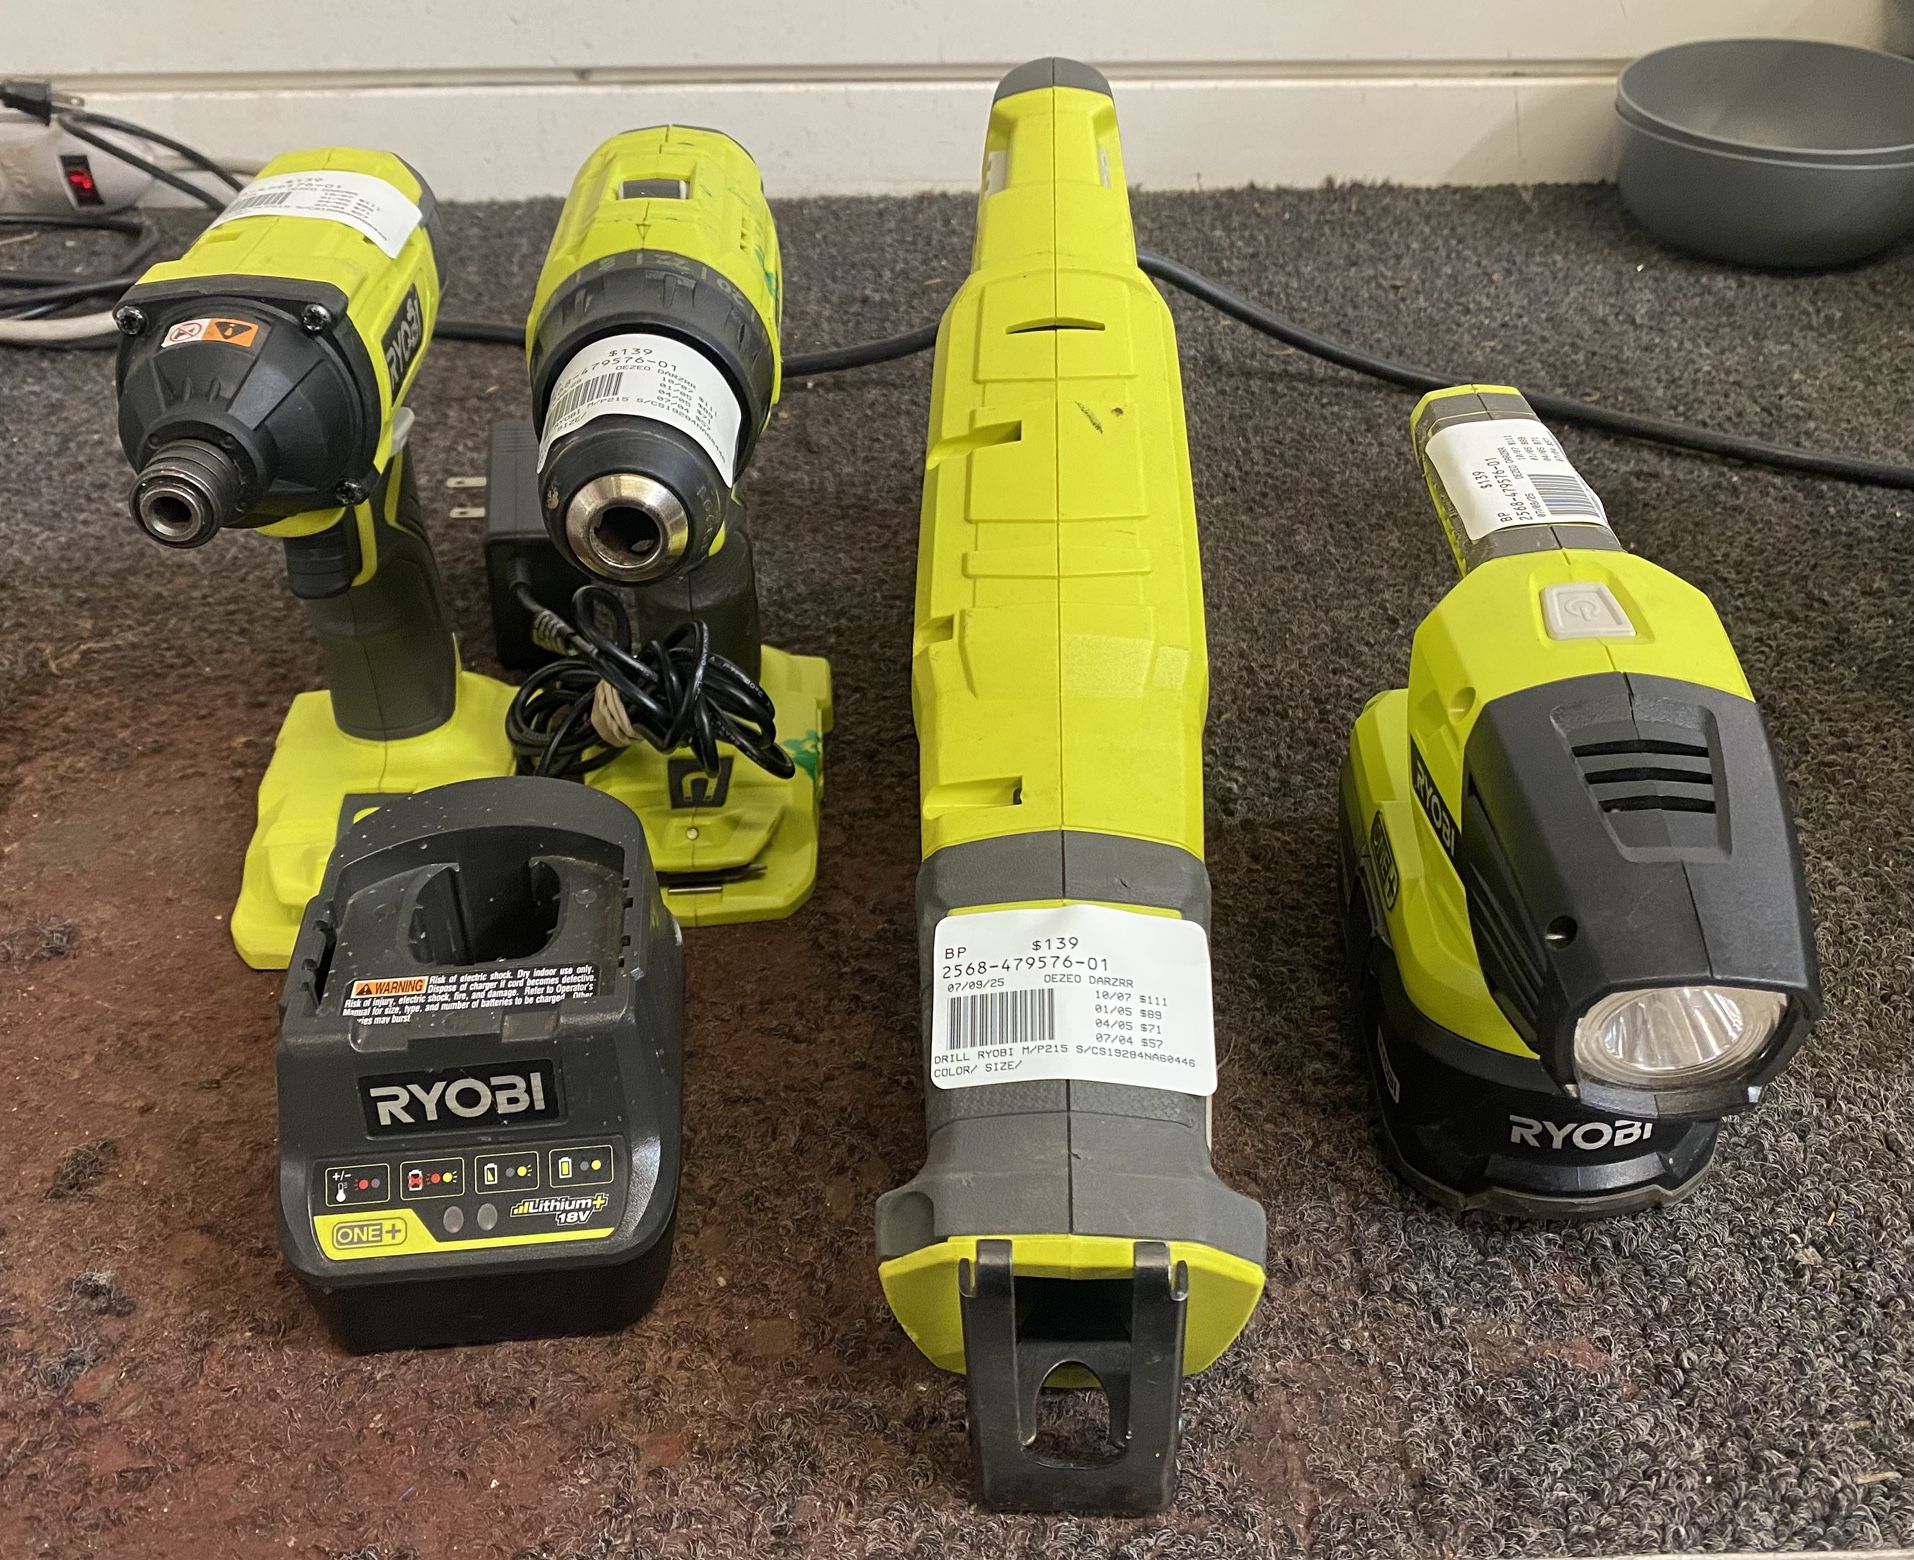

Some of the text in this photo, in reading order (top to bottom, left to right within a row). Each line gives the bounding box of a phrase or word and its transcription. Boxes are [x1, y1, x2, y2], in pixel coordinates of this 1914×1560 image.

[608, 348, 654, 358] $139
[1472, 471, 1493, 489] $139
[1484, 457, 1534, 521] 2568-479576-01
[1497, 512, 1513, 522] BP
[1416, 760, 1455, 857] RYOBI
[944, 946, 967, 960] BP
[1032, 936, 1079, 952] $139
[429, 964, 595, 984] Risk of electric shock. Dry indoor use only.
[942, 955, 1108, 979] 2568-479576-01
[375, 979, 423, 995] WARNING
[428, 974, 597, 994] Dispose of charger if cord becomes defective.
[947, 973, 1134, 993] 07/09/25 OEZEO DARZRR
[344, 982, 594, 1008] Risk of injury, electric shock, fire, and damage. Refer to Operator's
[1095, 989, 1168, 1007] 10/07 $111
[342, 1007, 370, 1016] Manual
[372, 1007, 383, 1016] for
[384, 1006, 402, 1015] size,
[404, 1004, 422, 1014] type,
[424, 1003, 439, 1012] and
[440, 1002, 470, 1010] number
[471, 1000, 479, 1009] of
[480, 998, 513, 1008] batteries
[514, 996, 522, 1005] to
[524, 996, 534, 1004] be
[1095, 1004, 1163, 1020] 01/05 $89
[1095, 1018, 1162, 1035] 04/05 $71
[1096, 1033, 1164, 1050] 07/04 $57
[934, 1051, 970, 1066] DRILL
[977, 1047, 1015, 1060] RYOBI
[1021, 1043, 1069, 1056] M/P215
[933, 1060, 1024, 1079] COLOR/ SIZE/
[369, 1072, 545, 1126] RYOBI
[1509, 1115, 1653, 1150] RYOBI
[558, 1210, 592, 1224] 18V
[335, 1222, 403, 1245] ONE+
